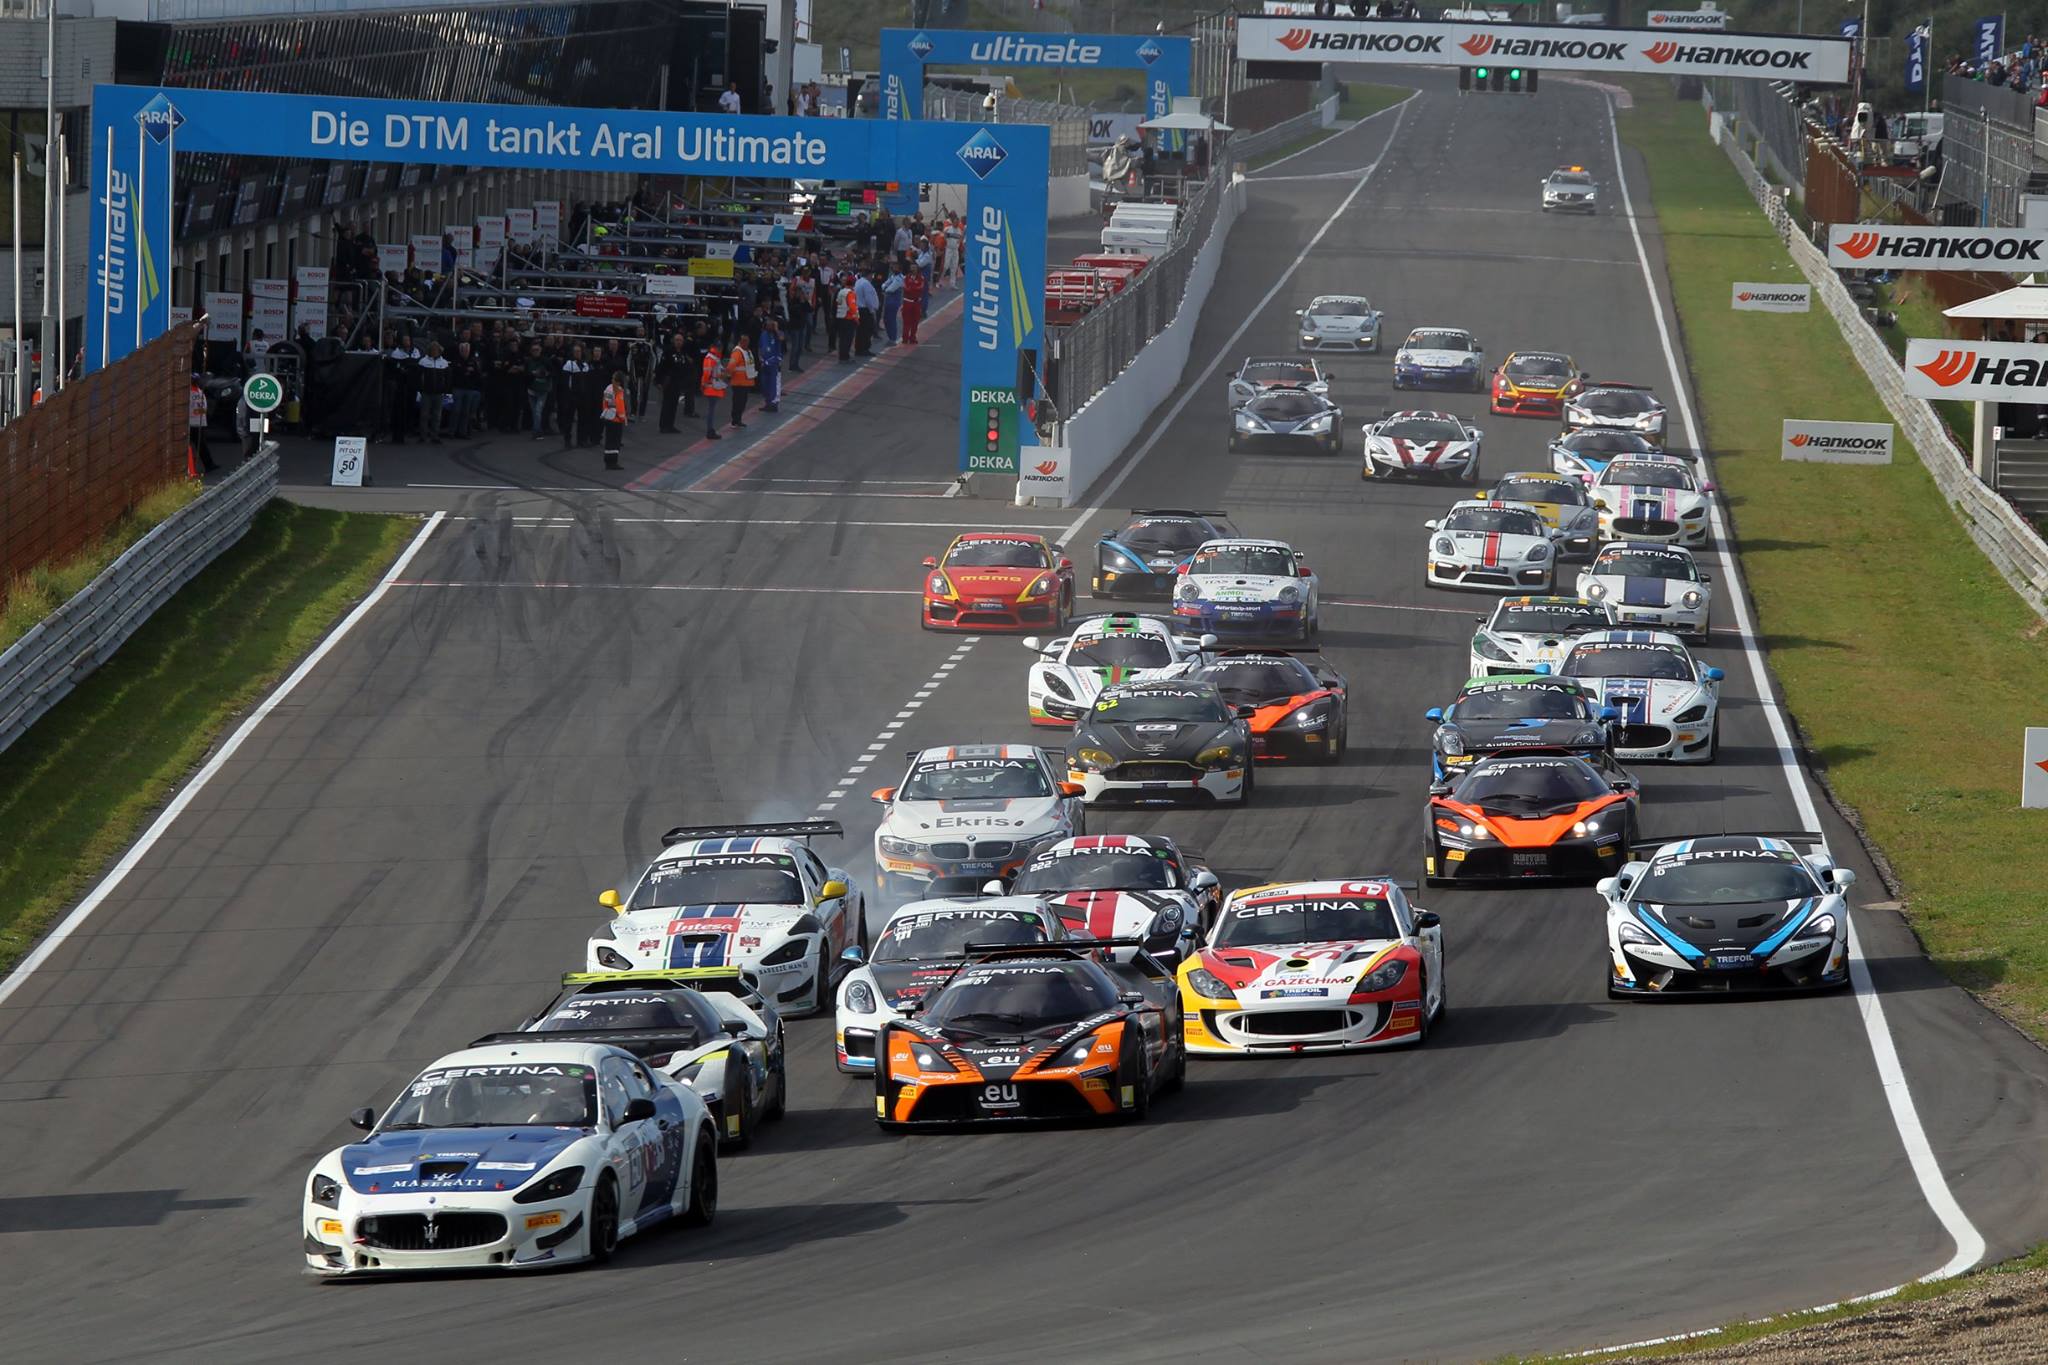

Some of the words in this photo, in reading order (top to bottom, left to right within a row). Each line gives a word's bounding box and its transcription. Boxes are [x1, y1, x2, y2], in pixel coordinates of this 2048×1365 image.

[910, 41, 932, 50] ARAL
[970, 36, 1102, 64] ultimate
[1139, 47, 1161, 57] ARAL
[311, 110, 370, 147] Die
[385, 114, 468, 151] DTM
[486, 118, 581, 156] tankt
[591, 123, 662, 160] Aral
[678, 126, 827, 165] Ultimate
[962, 146, 1000, 160] ARAL
[979, 205, 1002, 350] ultimate
[250, 391, 276, 400] DEKRA
[971, 390, 1016, 404] DEKRA
[342, 460, 355, 471] 50
[969, 456, 1014, 469] DEKRA
[1614, 461, 1681, 472] CERTINA
[1509, 478, 1574, 487] CERTINA
[1475, 507, 1525, 515] CERTINA
[957, 540, 1032, 548] CERTINA
[1204, 546, 1281, 555] CERTINA
[1609, 550, 1684, 561] CERTINA
[1508, 606, 1590, 615] CERTINA
[1078, 632, 1164, 642] CERTINA
[1580, 643, 1670, 651] CERTINA
[1467, 683, 1564, 696] CERTINA
[1103, 690, 1199, 701] CERTINA
[1096, 699, 1119, 712] 62
[918, 760, 1023, 773] CERTINA
[1488, 762, 1568, 770] CERTINA
[936, 815, 1010, 828] Ekris
[1037, 847, 1152, 862] CERTINA
[1655, 850, 1779, 865] CERTINA
[658, 856, 775, 871] CERTINA
[1030, 860, 1052, 873] 222
[1653, 868, 1665, 878] 10
[650, 876, 661, 885] 71
[1231, 902, 1247, 913] 26
[1235, 901, 1360, 919] CERTINA
[896, 911, 1020, 927] CERTINA
[675, 921, 734, 933] Intesa
[967, 967, 1065, 977] CERTINA
[1264, 976, 1347, 987] GAZECHIM
[568, 997, 667, 1008] CERTINA
[979, 1055, 1021, 1064] .eu
[422, 1066, 564, 1082] CERTINA
[411, 1086, 432, 1098] 60
[978, 1084, 1018, 1102] .eu
[391, 1178, 484, 1189] MASERATI
